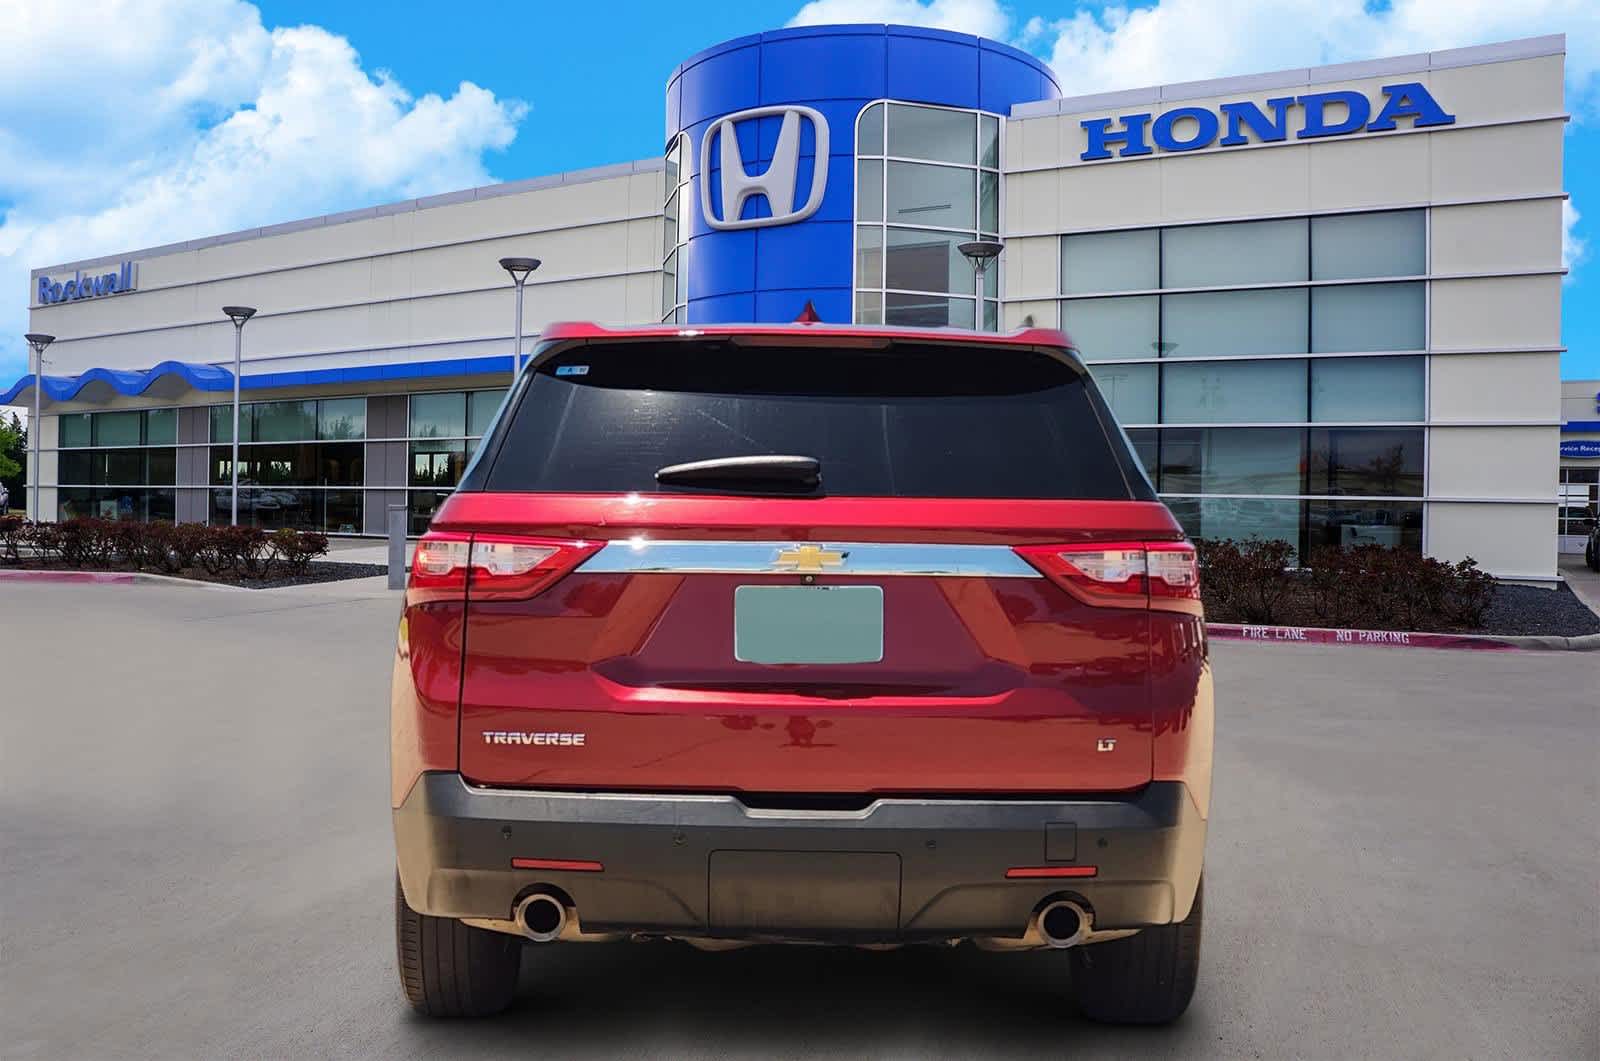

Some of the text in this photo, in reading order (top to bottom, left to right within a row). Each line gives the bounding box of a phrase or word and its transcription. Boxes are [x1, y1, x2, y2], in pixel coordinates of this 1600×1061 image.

[1080, 82, 1456, 161] HONDA
[38, 261, 133, 304] Rockwall
[1242, 626, 1410, 644] FIRE LANE NO PARKING
[482, 731, 585, 746] TRAVERSE
[1097, 739, 1117, 752] LT
